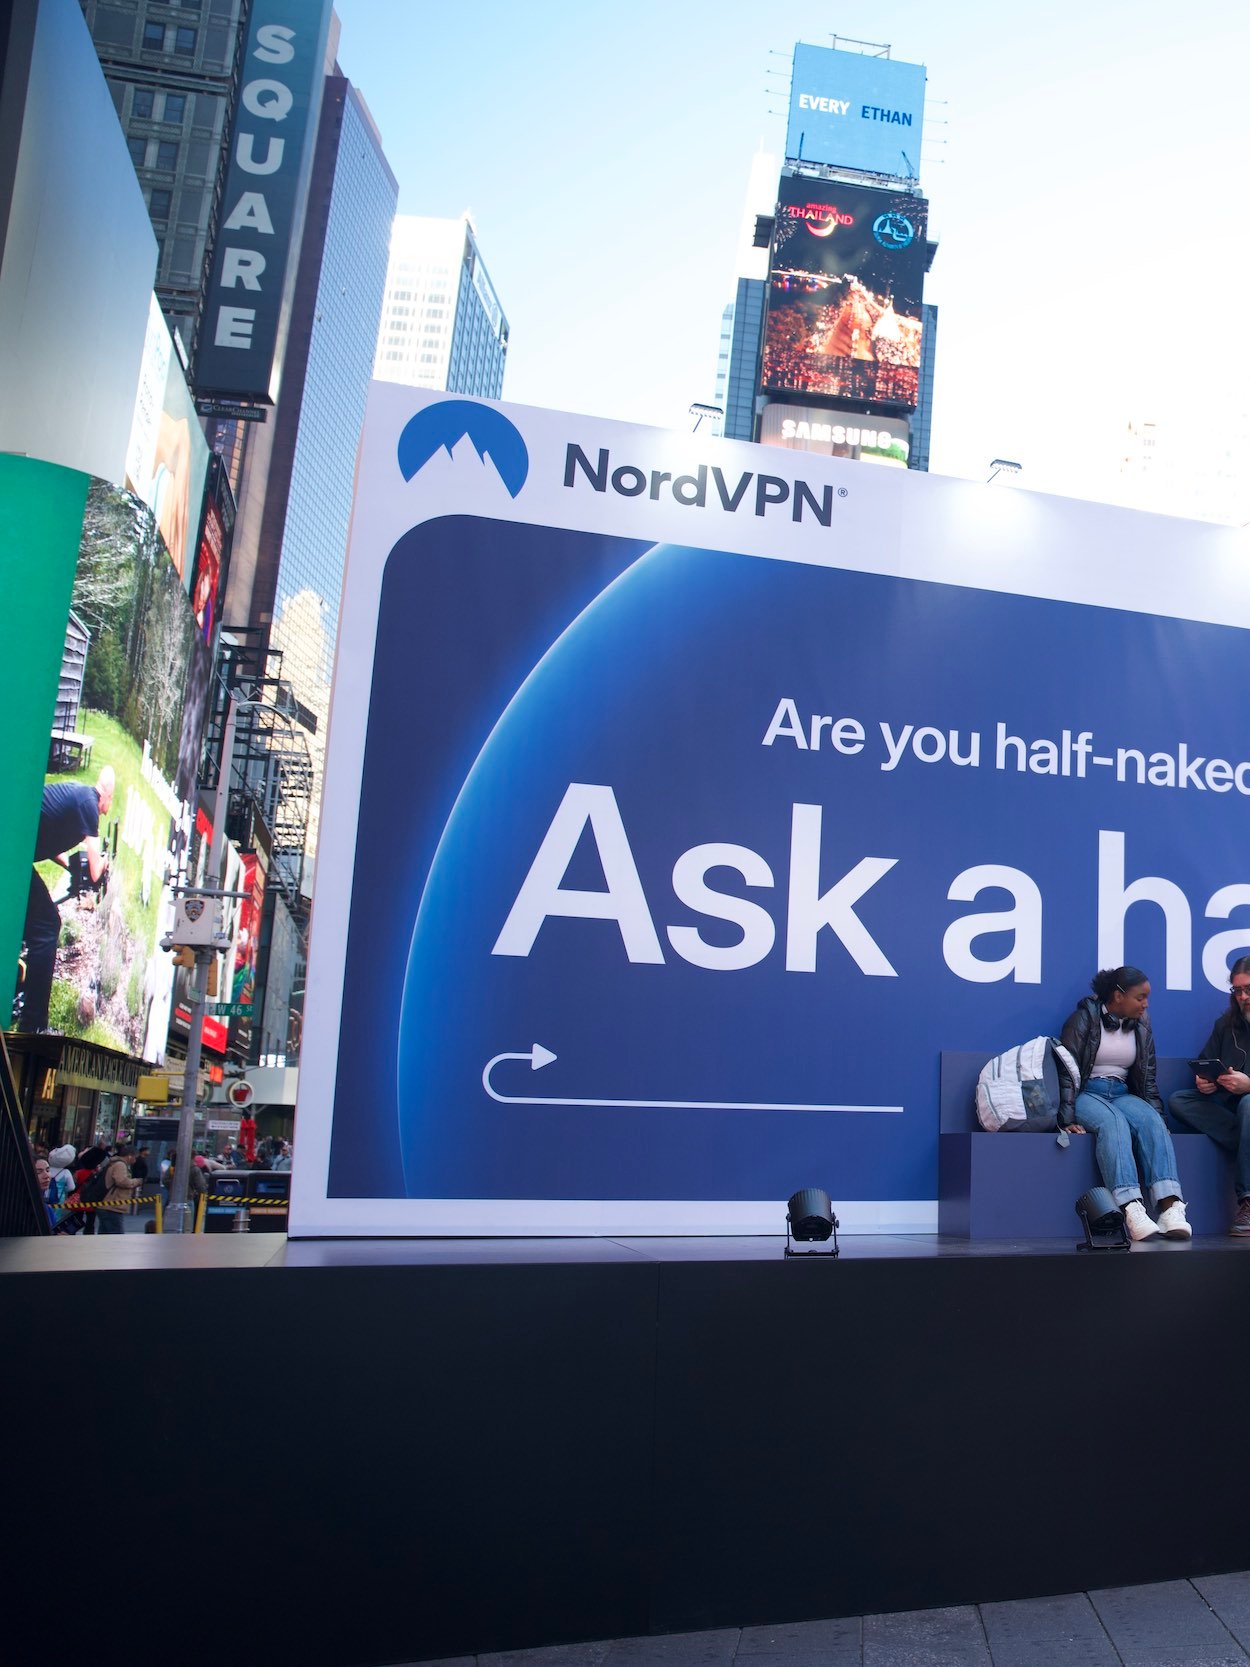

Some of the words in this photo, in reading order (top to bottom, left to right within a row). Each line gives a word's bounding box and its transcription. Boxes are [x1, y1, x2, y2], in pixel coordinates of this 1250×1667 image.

[799, 94, 850, 115] EVERY
[861, 105, 912, 126] ETHAN
[214, 24, 296, 350] SQUARE
[789, 205, 853, 226] THAILAND
[806, 202, 837, 213] amazing
[781, 419, 892, 449] SAMSUNG
[762, 698, 866, 755] Are
[879, 721, 980, 772] you
[491, 783, 899, 977] Ask
[943, 864, 1043, 984] a
[217, 1004, 227, 1015] W
[230, 1005, 242, 1016] 46
[58, 1045, 104, 1080] AMERICAN
